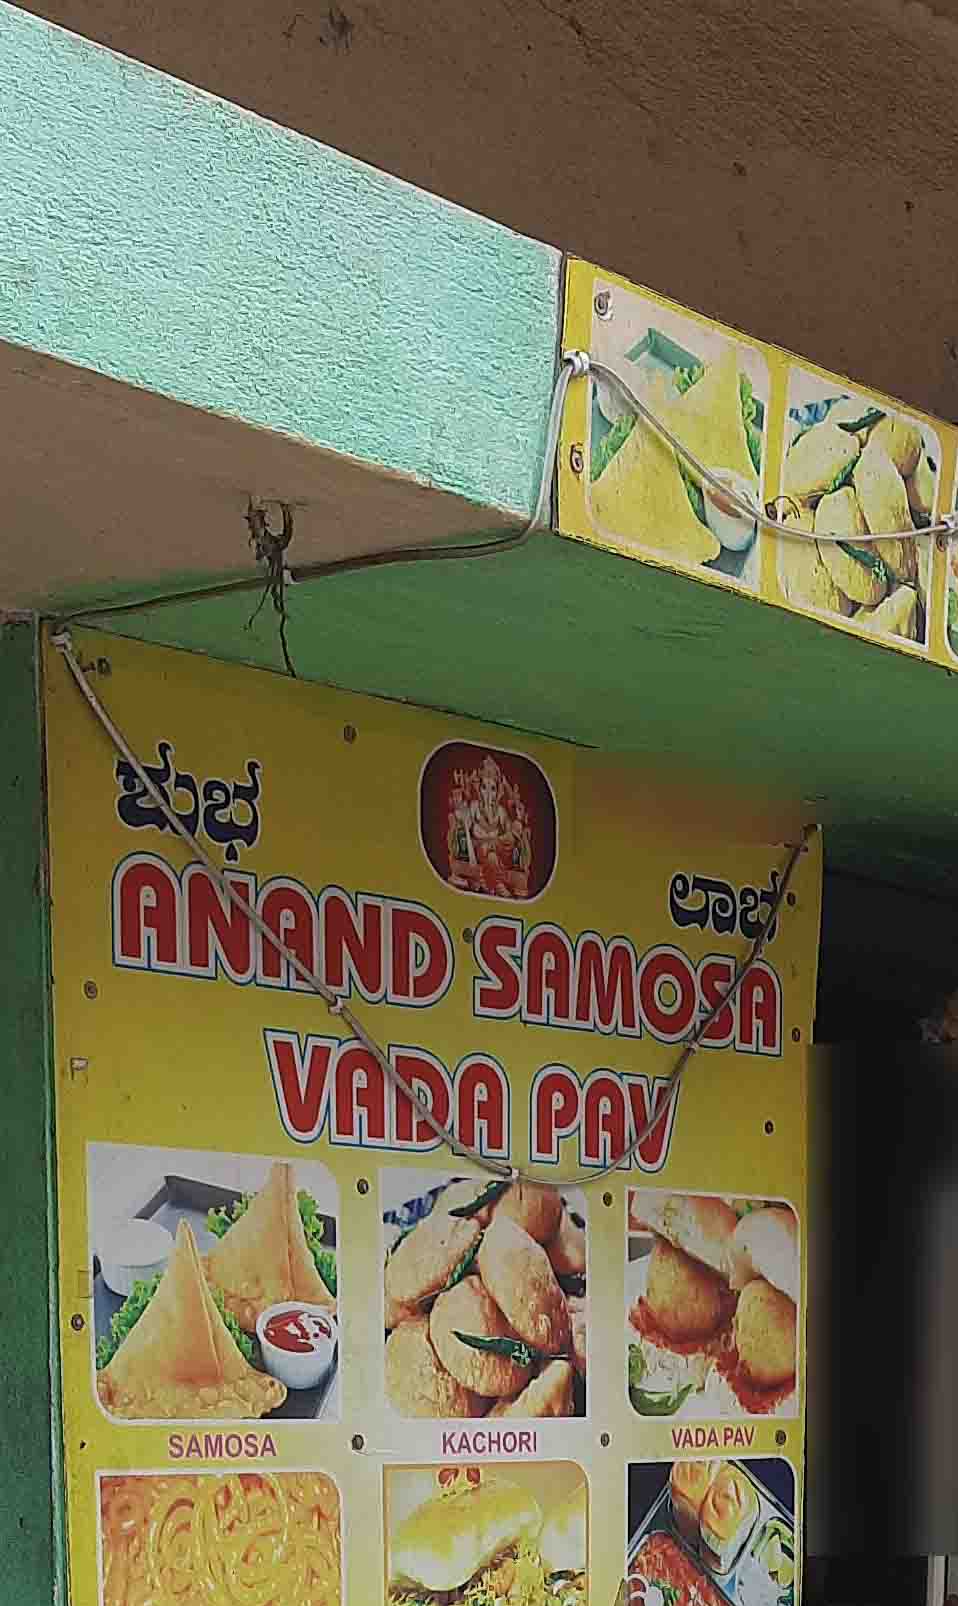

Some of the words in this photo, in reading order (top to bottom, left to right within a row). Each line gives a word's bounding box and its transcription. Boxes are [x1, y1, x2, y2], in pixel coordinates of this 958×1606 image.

[112, 850, 454, 1008] ANAND
[472, 915, 783, 1056] SAMOSA
[262, 1028, 510, 1160] VADA
[529, 1061, 681, 1173] PAV
[168, 1433, 277, 1458] SAMOSA
[441, 1431, 538, 1454] KACHORI
[671, 1427, 718, 1447] VADA
[723, 1427, 756, 1447] PAV
